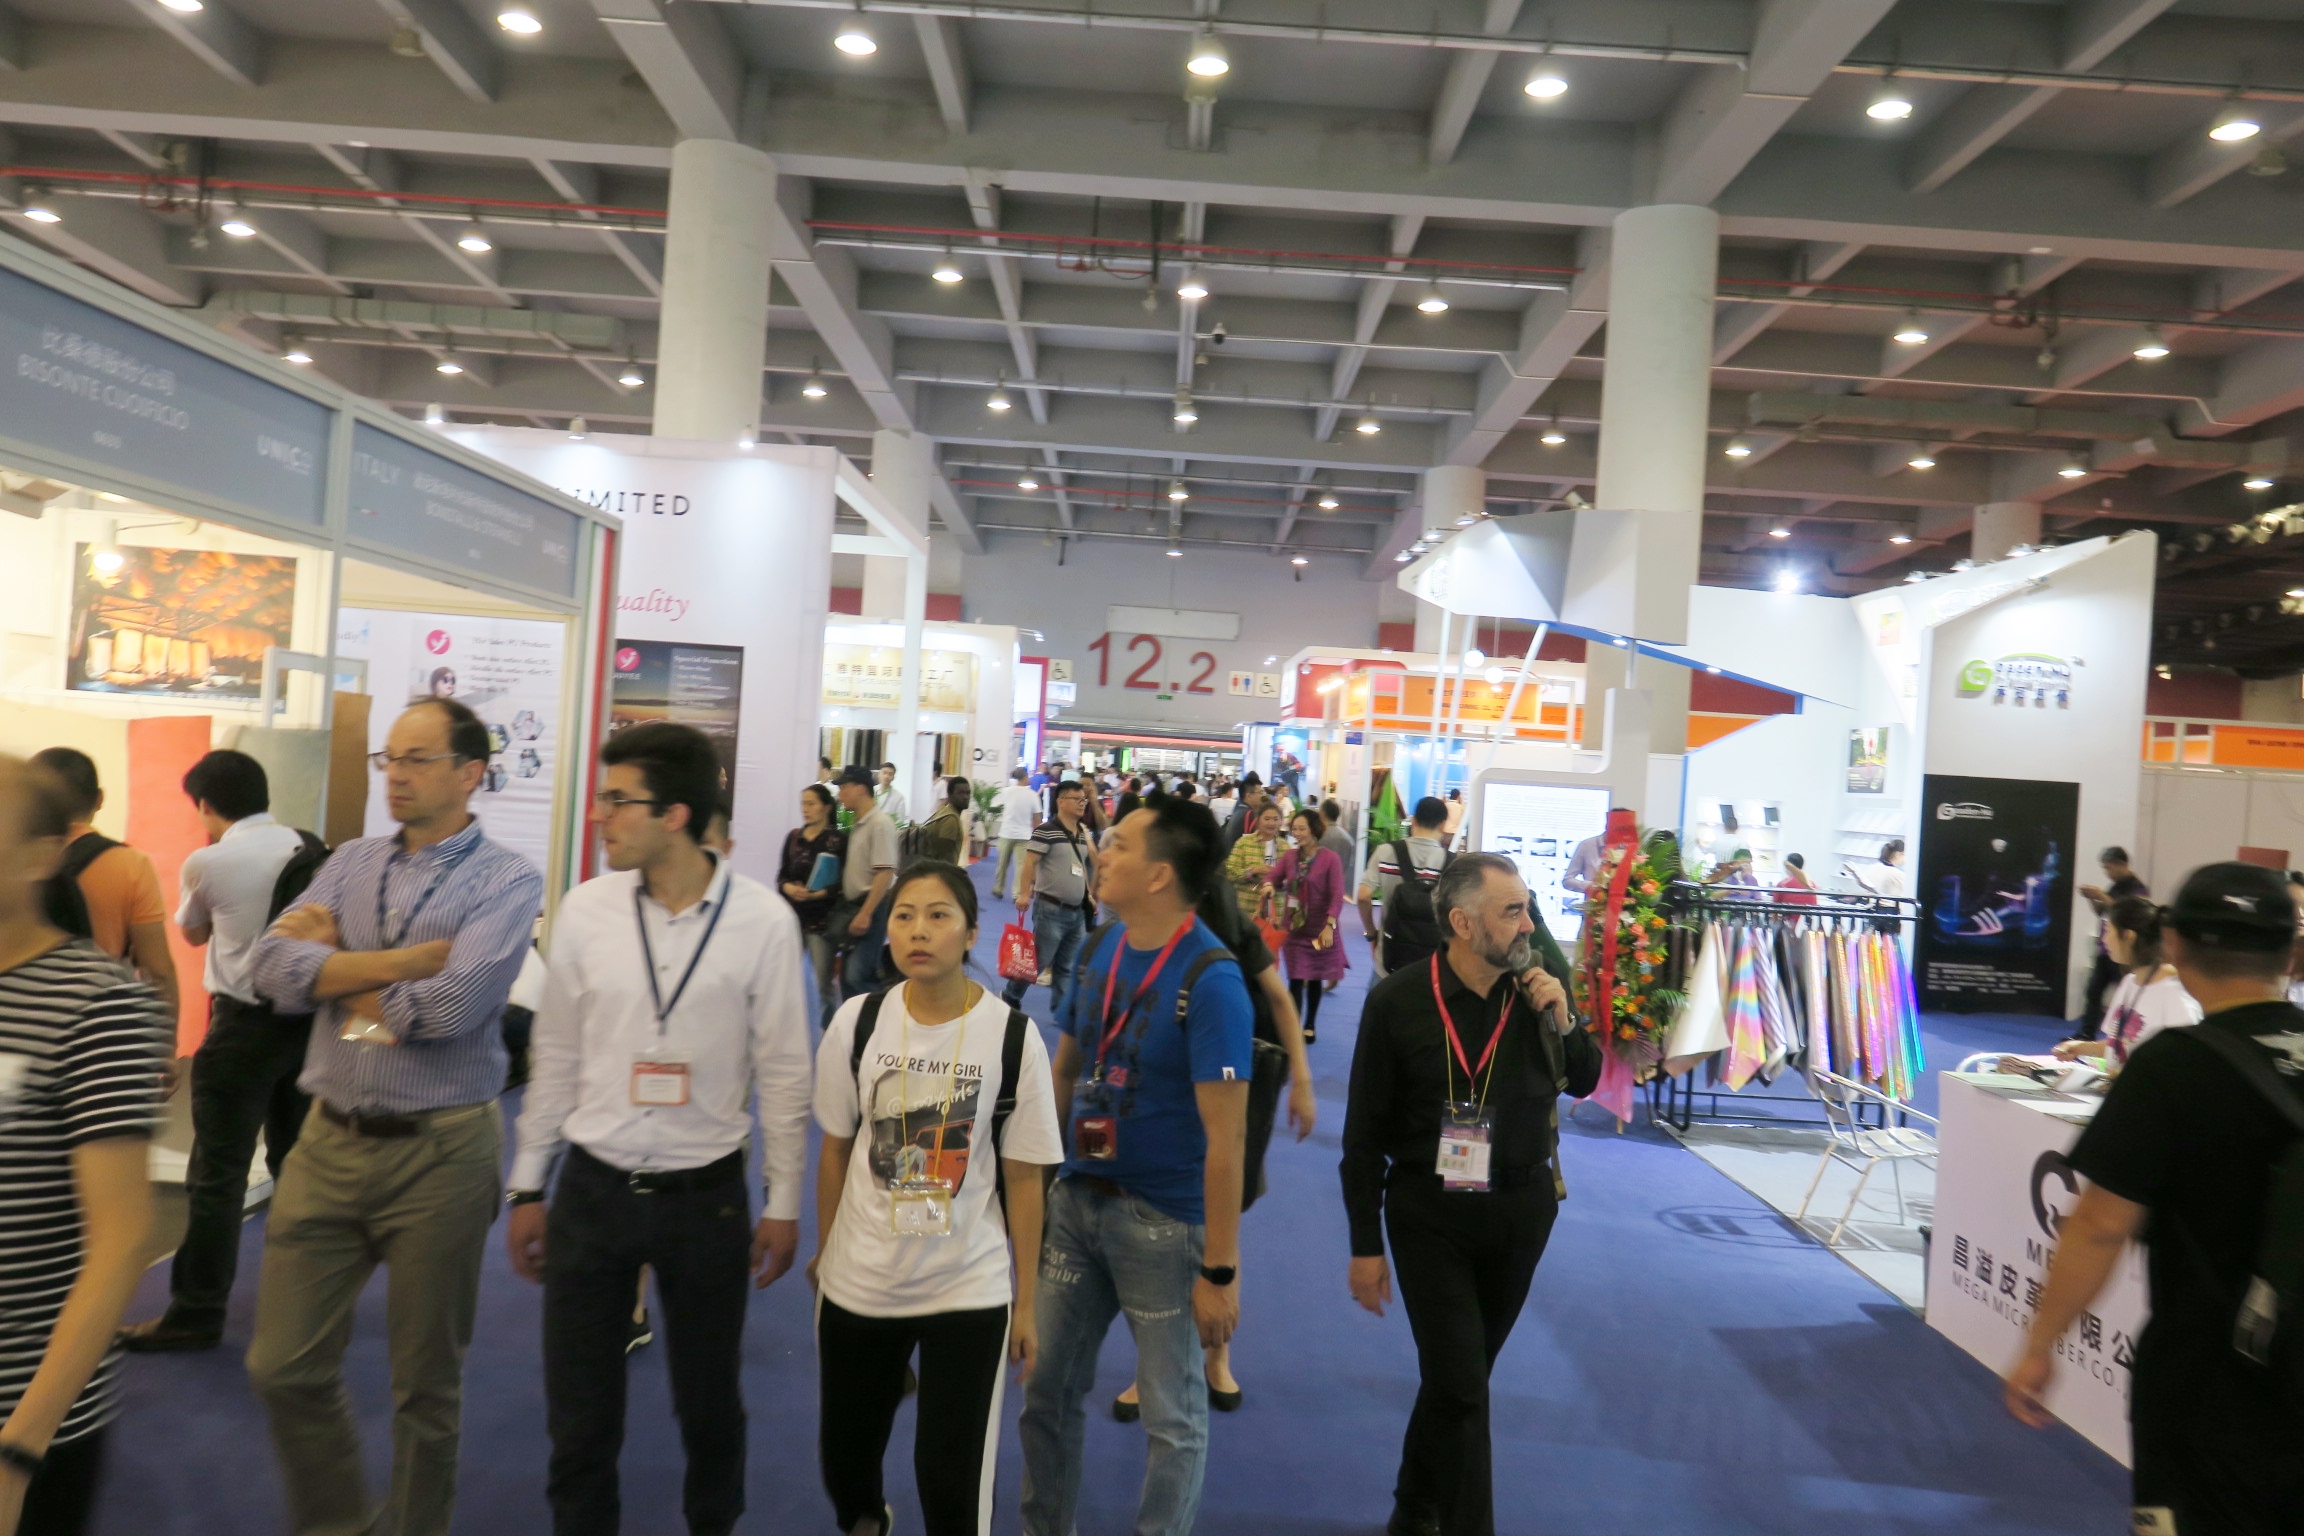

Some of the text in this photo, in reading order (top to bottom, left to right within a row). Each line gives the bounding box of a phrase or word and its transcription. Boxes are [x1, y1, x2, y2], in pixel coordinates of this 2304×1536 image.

[570, 487, 691, 516] IMITED
[616, 588, 690, 622] uality
[1088, 631, 1217, 694] 12.2
[876, 1053, 983, 1078] YOU'RE MY GIRL
[1953, 1270, 1990, 1307] MEGA
